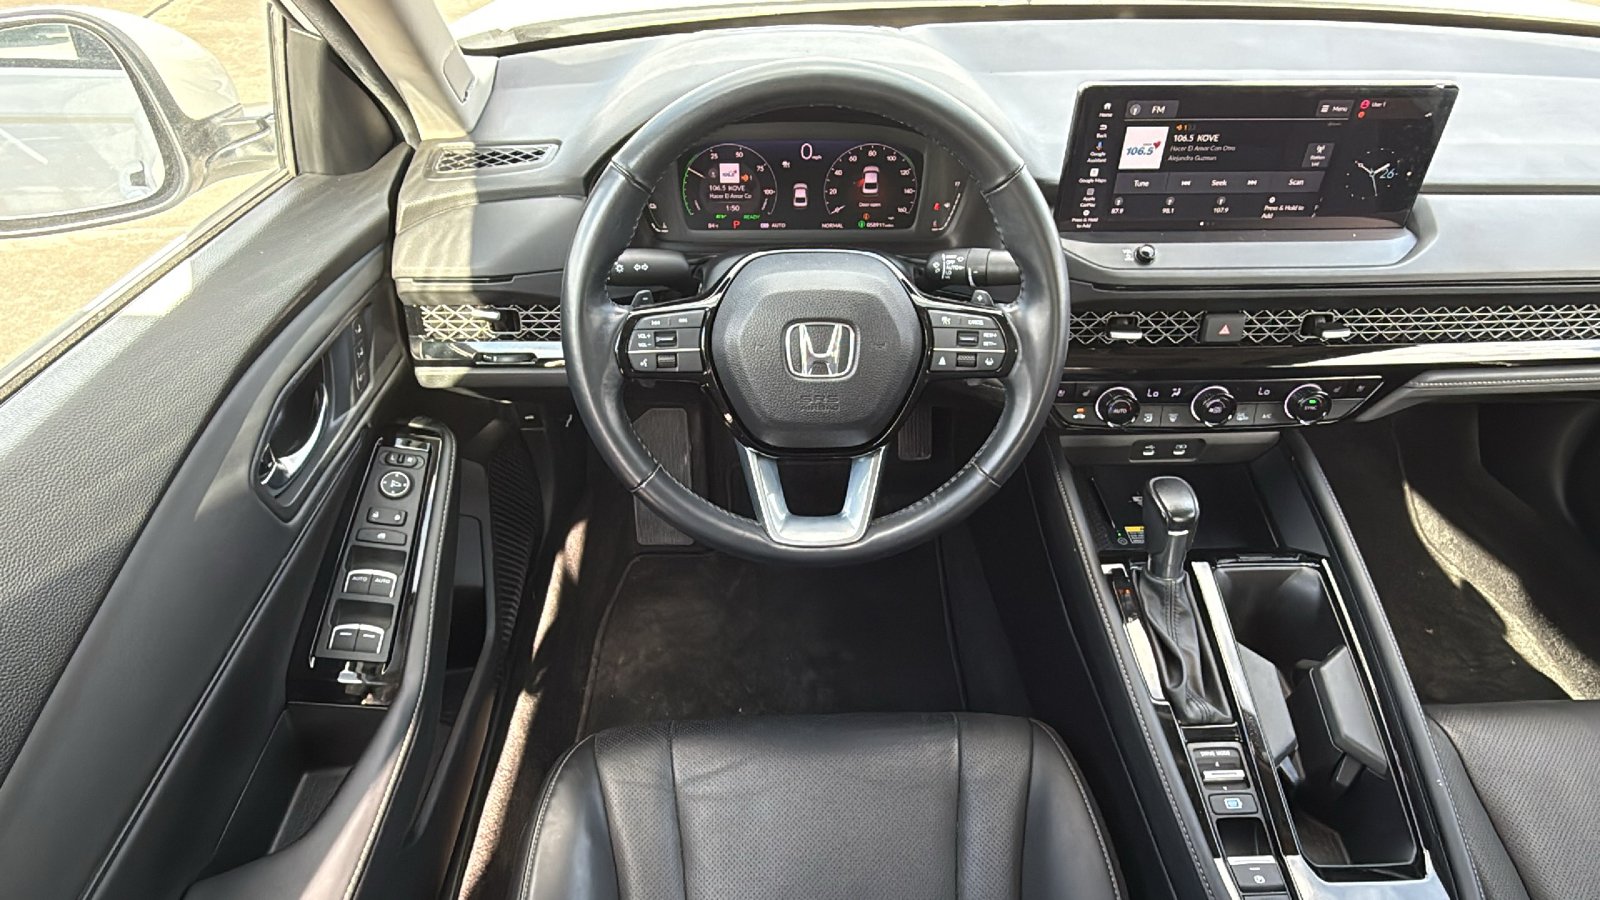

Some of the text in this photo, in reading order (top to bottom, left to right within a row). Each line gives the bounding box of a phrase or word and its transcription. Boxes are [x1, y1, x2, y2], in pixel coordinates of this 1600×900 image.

[1151, 105, 1166, 114] FM
[1173, 134, 1220, 142] 106.5 KOVE
[1127, 147, 1154, 155] 106.5
[1379, 169, 1395, 179] 26
[1134, 180, 1150, 188] Tune
[733, 220, 741, 229] P
